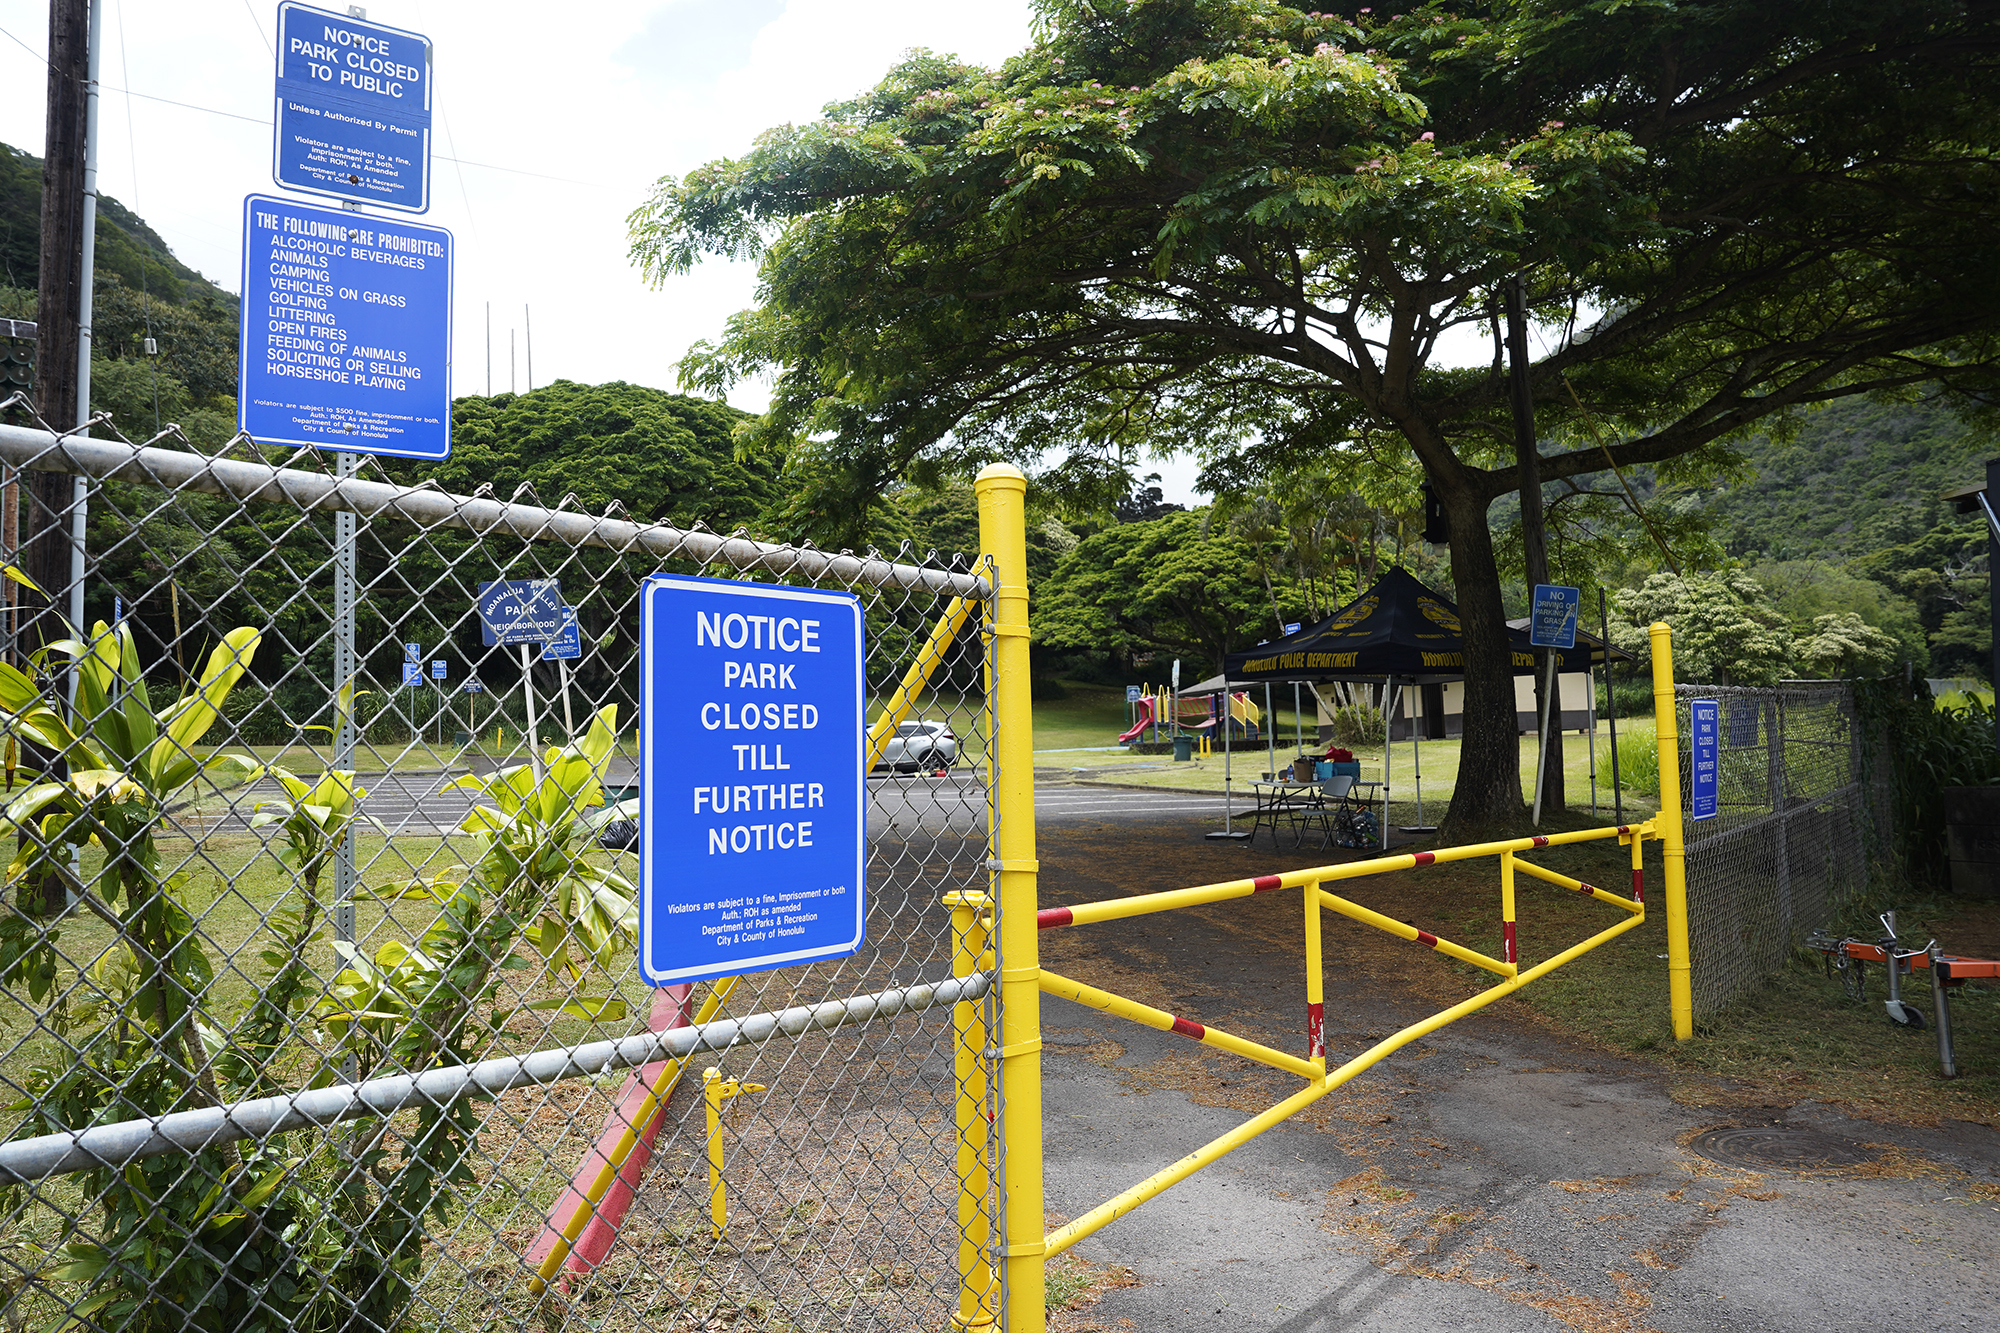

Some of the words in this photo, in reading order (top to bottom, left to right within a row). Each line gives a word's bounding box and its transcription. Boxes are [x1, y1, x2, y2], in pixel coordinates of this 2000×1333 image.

[325, 26, 389, 56] NOTICE
[291, 38, 338, 63] PARK
[347, 53, 419, 82] CLOSED
[308, 62, 332, 81] TO
[341, 70, 402, 98] PUBLIC
[290, 102, 320, 115] Unless
[324, 111, 372, 127] Authorized
[375, 122, 386, 131] By
[390, 125, 417, 137] Permit
[294, 135, 329, 151] Violators
[347, 147, 375, 158] subject
[377, 152, 385, 160] to
[299, 163, 336, 176] Department
[346, 173, 364, 182] Pks
[372, 178, 405, 189] Recreation
[351, 162, 361, 170] As
[363, 164, 399, 177] Amended
[334, 176, 356, 186] Coun
[366, 183, 393, 193] Honolulu
[257, 212, 278, 230] THE
[284, 216, 347, 242] FOLLOWING
[351, 228, 374, 247] ARE
[378, 231, 444, 258] PROHIBITED:
[271, 235, 345, 256] ALCOHOLIC
[351, 248, 425, 269] BEVERAGES
[271, 249, 328, 268] ANIMALS
[270, 263, 329, 282] CAMPING
[270, 277, 333, 297] VEHICLES
[339, 288, 357, 300] ON
[363, 291, 406, 307] GRASS
[270, 292, 326, 310] GOLFING
[269, 306, 335, 325] LITTERING
[269, 320, 304, 335] OPEN
[311, 326, 346, 341] FIRES
[269, 335, 324, 352] FEEDING
[330, 343, 347, 354] OF
[352, 346, 406, 362] ANIMALS
[267, 349, 340, 368] SOLICITING
[346, 359, 364, 371] OR
[370, 362, 420, 379] SELLING
[267, 363, 349, 383] HORSESHOE
[355, 374, 405, 390] PLAYING
[253, 399, 283, 408] Violators
[300, 403, 324, 412] subject
[336, 408, 353, 416] $500
[293, 417, 330, 426] Department
[370, 424, 405, 434] Recreation
[327, 427, 349, 435] County
[359, 417, 388, 425] Amended
[485, 587, 524, 616] MOANALUA
[532, 589, 558, 612] VLLEY
[1536, 600, 1564, 609] DRIVING
[1550, 591, 1565, 601] NO
[1535, 608, 1564, 617] PARKING
[1543, 616, 1565, 625] GRAS
[698, 612, 820, 652] NOTICE
[1241, 655, 1279, 673] HONOLULU
[1279, 652, 1306, 669] POLICE
[1306, 651, 1359, 668] DEPARTMENT
[1421, 651, 1465, 667] HONOLUL
[725, 662, 796, 689] PARK
[701, 703, 818, 730] CLOSED
[1698, 709, 1714, 720] NOTICE
[1701, 724, 1712, 733] PARK
[1698, 736, 1714, 746] CLOSED
[733, 745, 790, 770] TILL
[1702, 749, 1710, 758] TILL
[1698, 761, 1714, 771] FURTHER
[1699, 773, 1713, 783] NOTICE
[695, 783, 823, 813] FURTHER
[709, 822, 812, 854] NOTICE
[667, 902, 701, 915] Violators
[703, 902, 715, 910] are
[717, 897, 744, 910] subject
[746, 897, 753, 905] to
[763, 894, 777, 903] fine,
[779, 889, 821, 902] Imprisonment
[831, 885, 846, 895] both
[744, 907, 759, 917] ROH
[771, 902, 802, 915] amended
[702, 923, 744, 936] Department
[746, 920, 753, 929] of
[756, 918, 774, 928] Parks
[776, 916, 781, 925] &
[783, 912, 818, 925] Recreation
[717, 936, 731, 946] City
[734, 934, 739, 943] &
[742, 931, 766, 942] County
[768, 929, 775, 938] of
[778, 926, 805, 937] Honolulu
